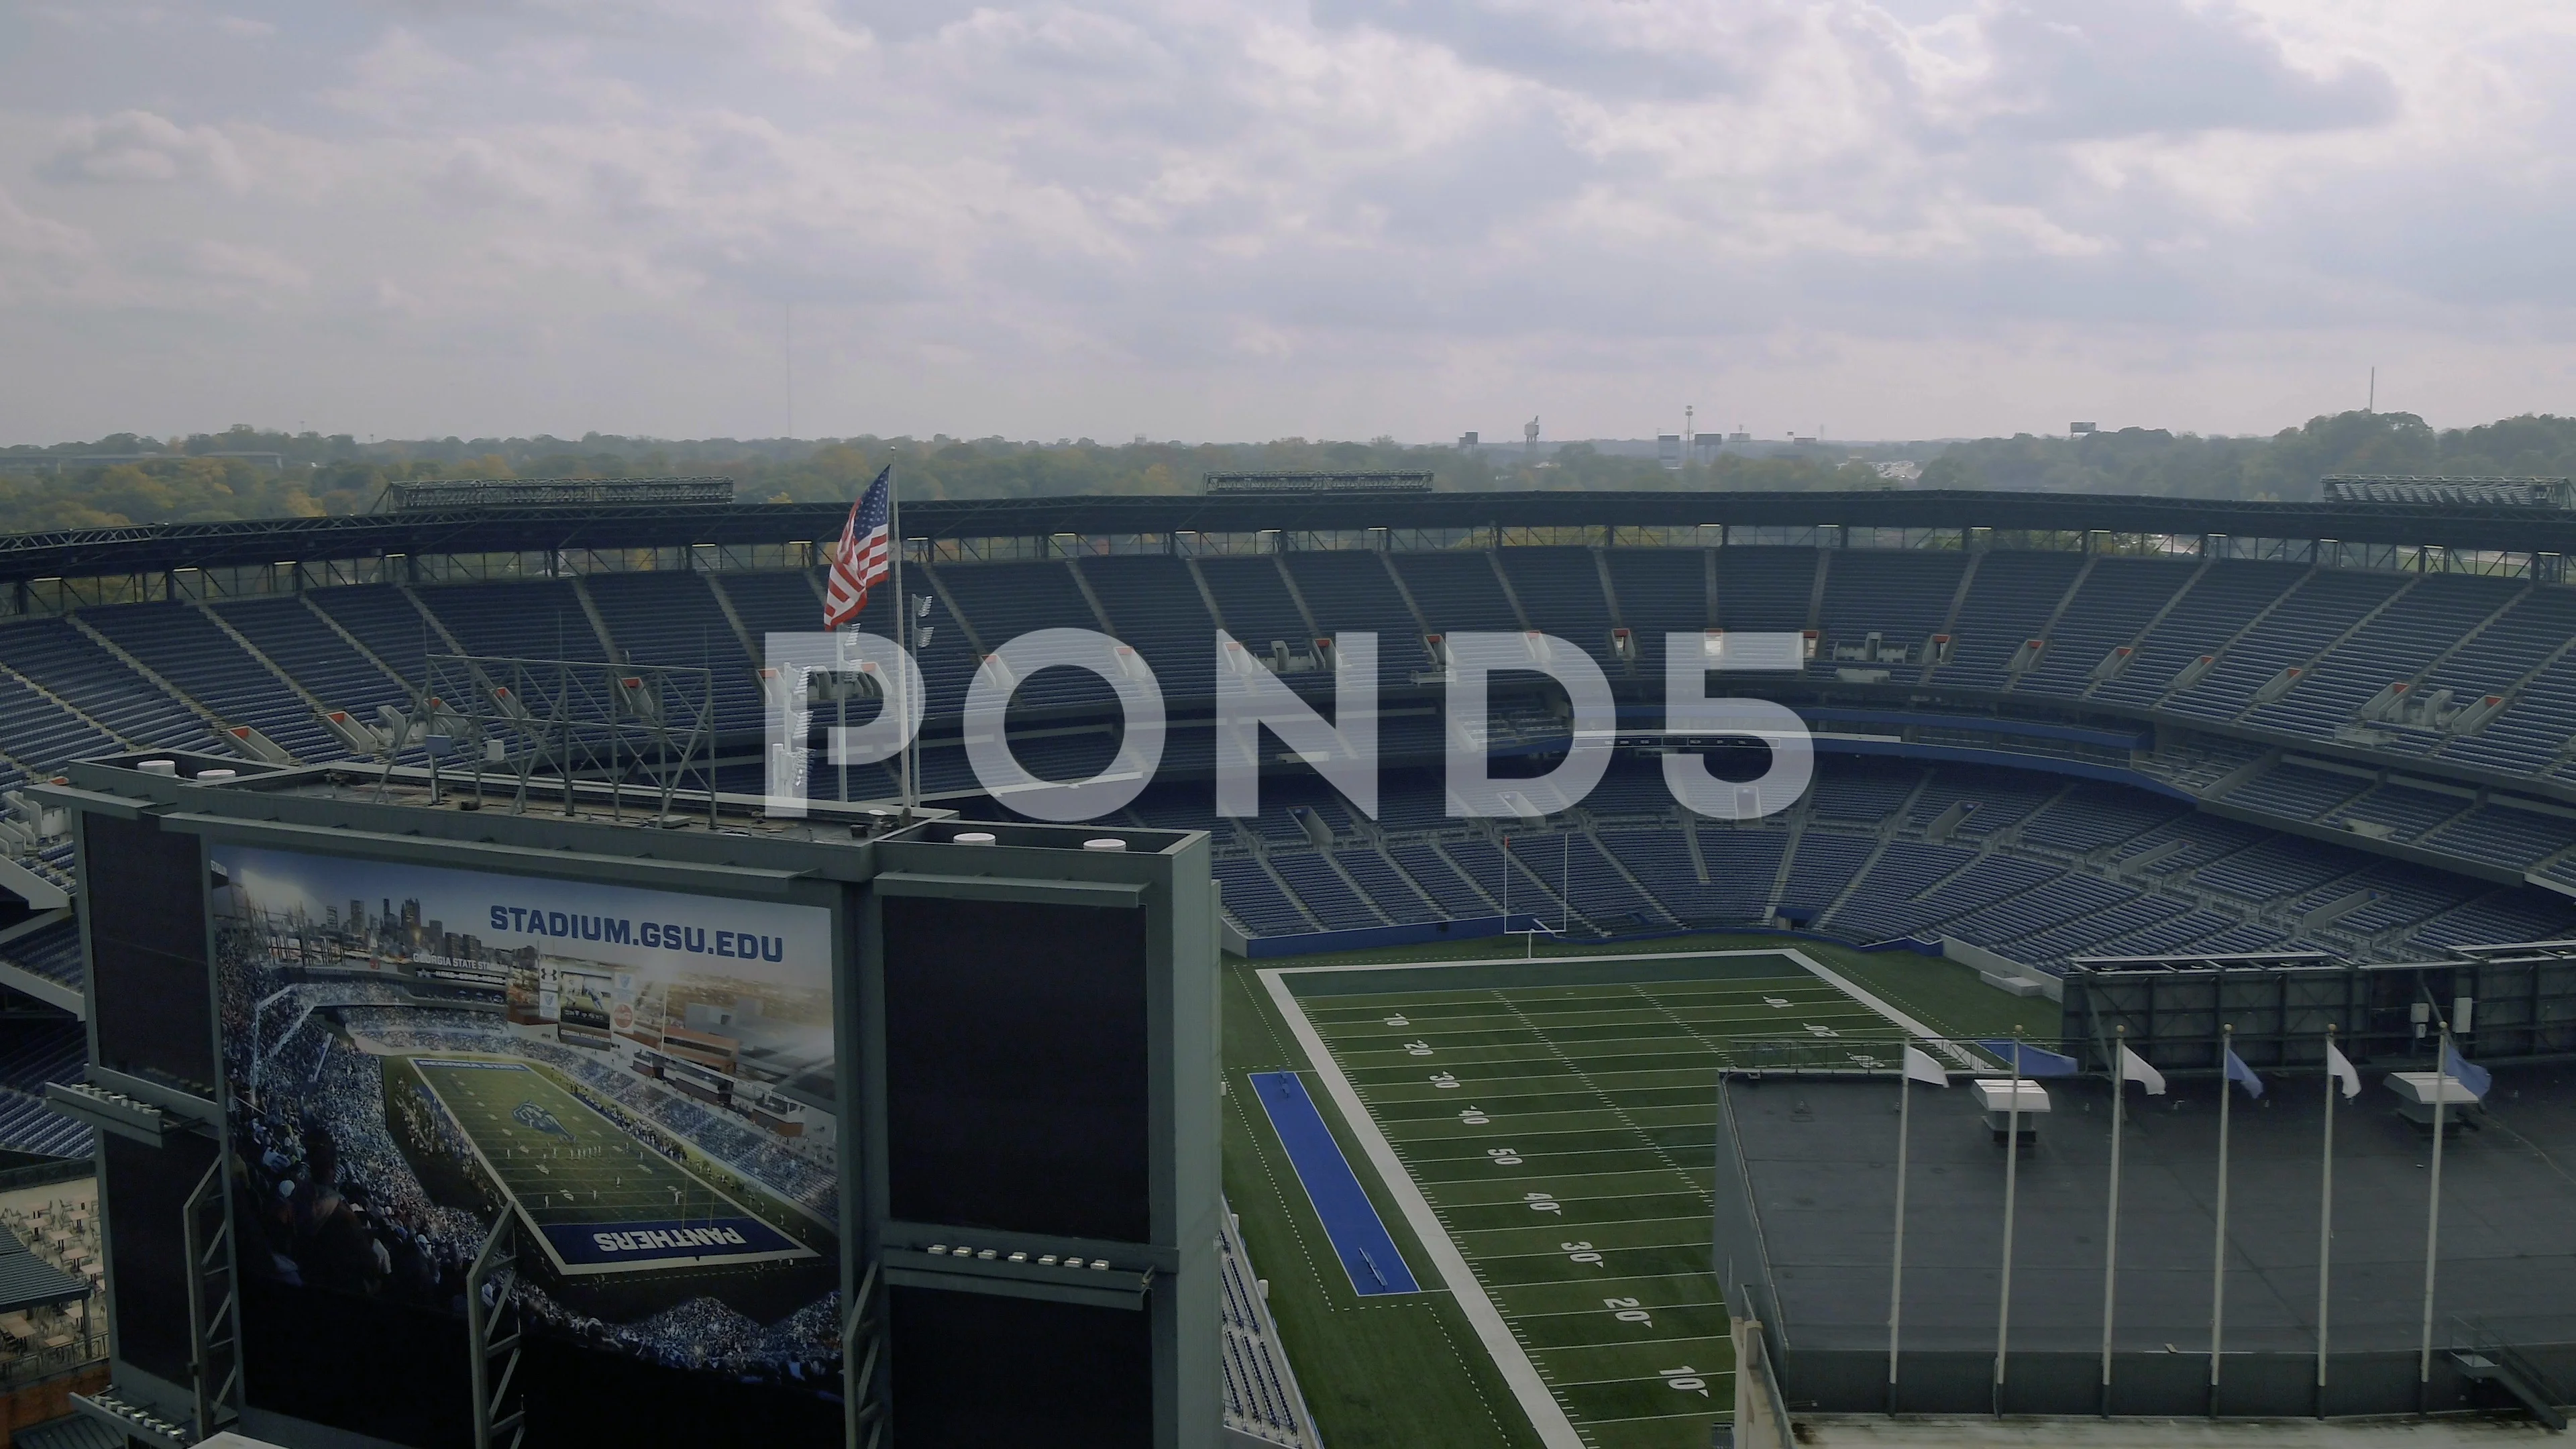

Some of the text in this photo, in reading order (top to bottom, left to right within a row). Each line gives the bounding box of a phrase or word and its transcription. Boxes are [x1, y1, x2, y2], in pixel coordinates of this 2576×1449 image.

[490, 905, 783, 963] STADIUM.GSU.EDU
[453, 958, 476, 969] STATE
[1383, 1016, 1409, 1026] 10
[1403, 1043, 1434, 1055] 20
[1429, 1075, 1461, 1088] 30
[1458, 1110, 1490, 1124] 40
[1487, 1148, 1523, 1165] 50
[1523, 1192, 1560, 1210] 40
[593, 1227, 747, 1252] PANTHERS
[1560, 1242, 1602, 1262] 30
[1603, 1297, 1650, 1321] 20
[1659, 1366, 1706, 1390] 10
